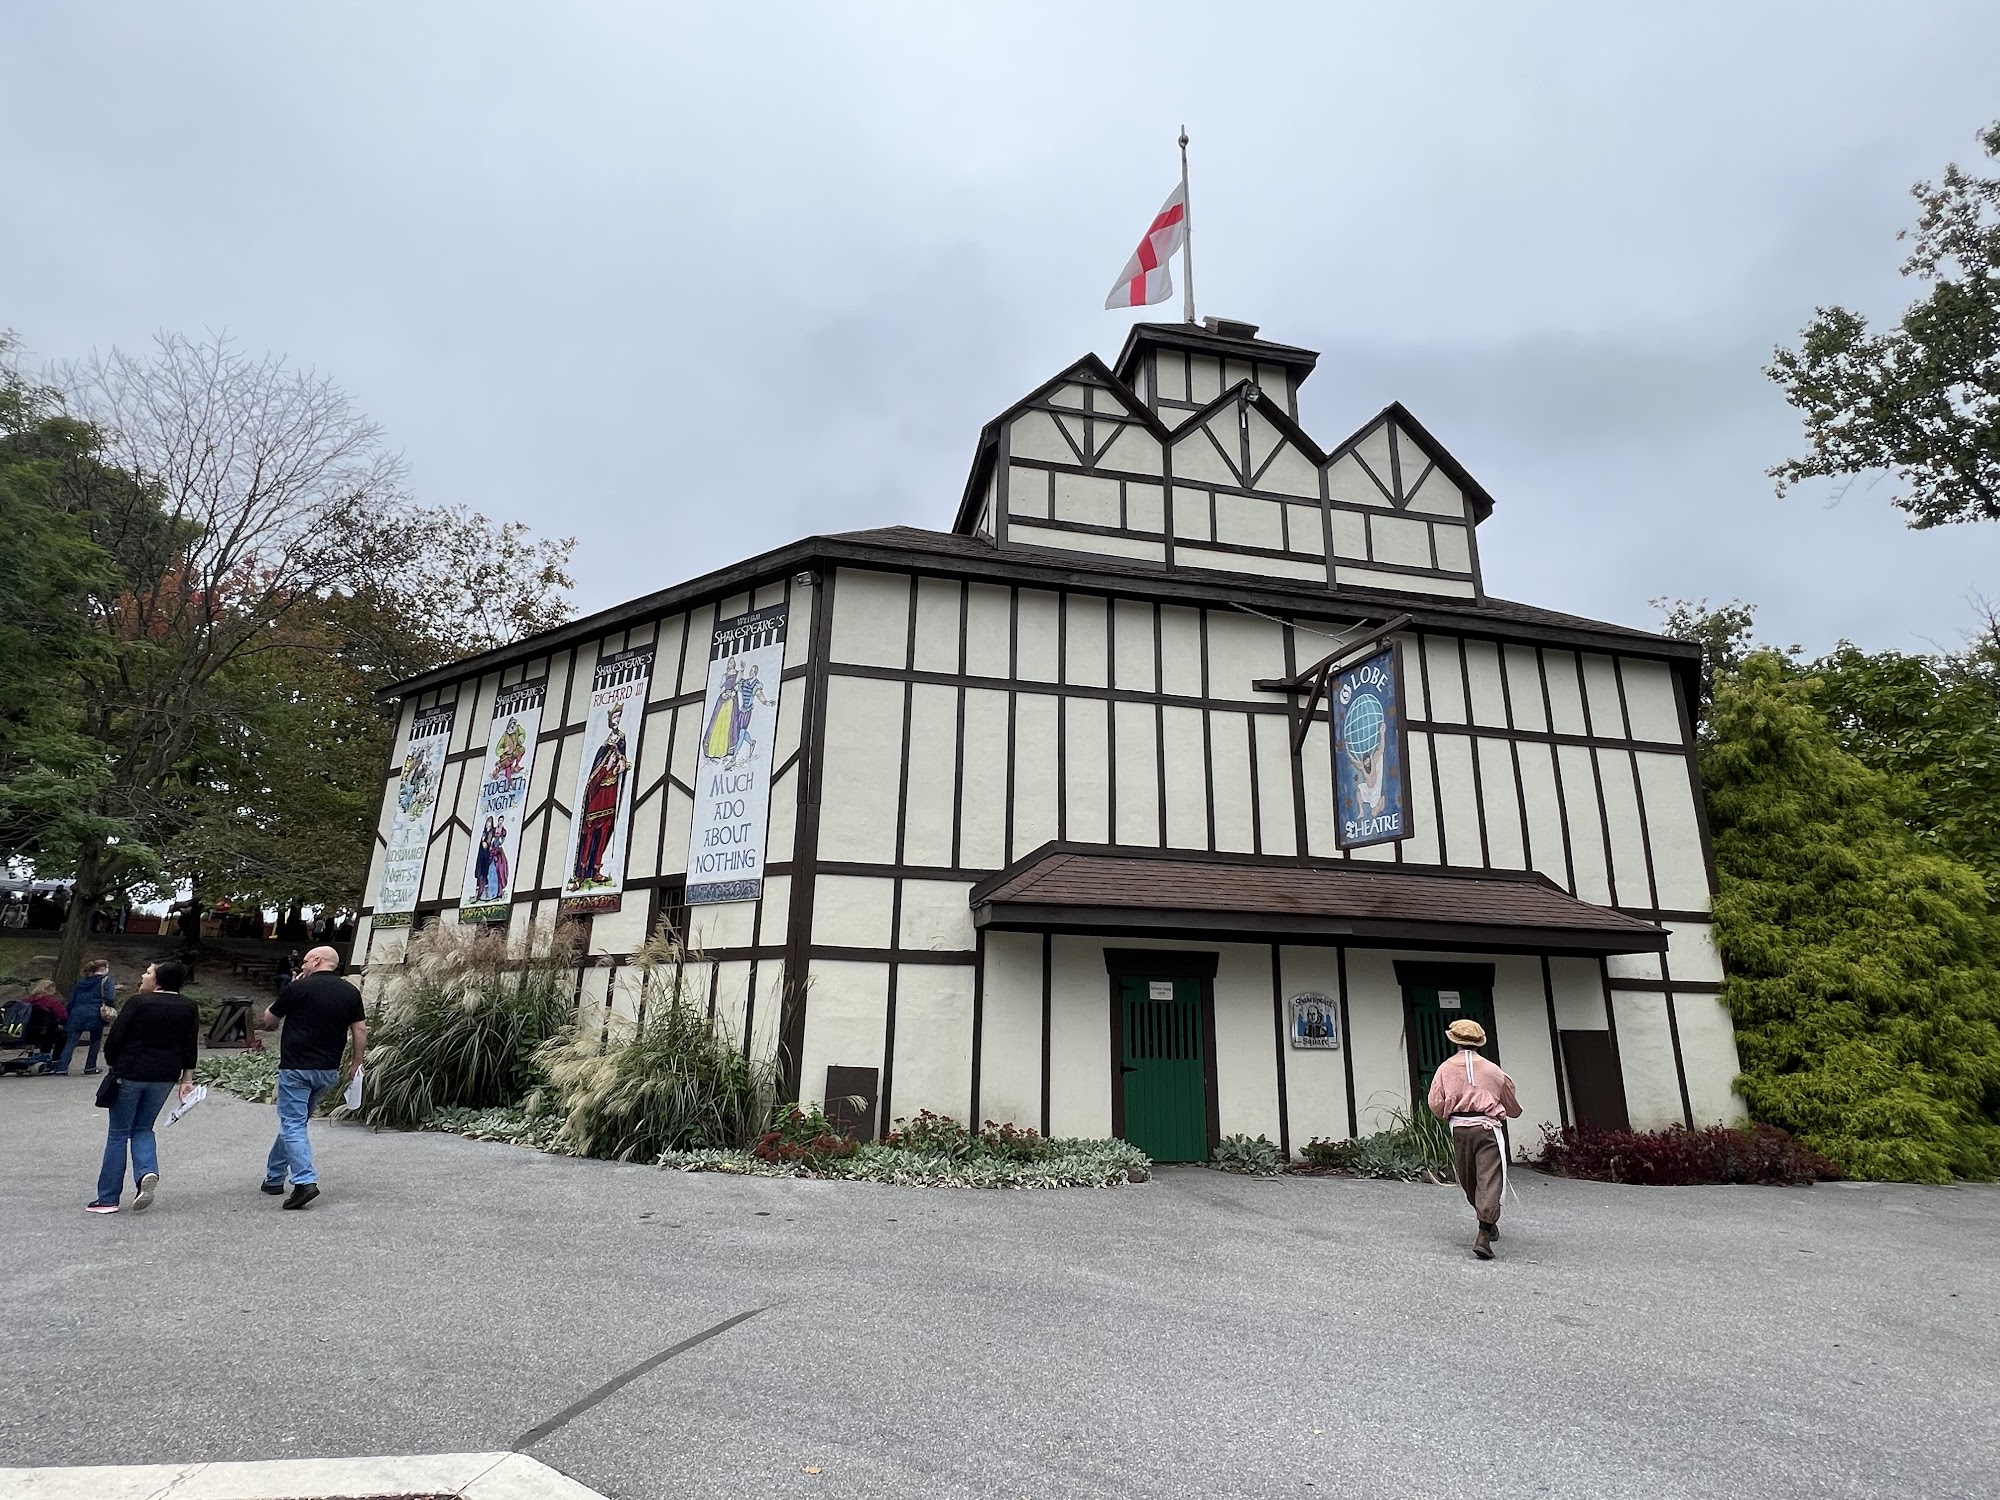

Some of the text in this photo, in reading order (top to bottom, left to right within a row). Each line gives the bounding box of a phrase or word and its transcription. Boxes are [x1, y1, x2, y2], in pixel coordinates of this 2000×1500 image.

[713, 614, 786, 646] SHAKESPEARE'S
[595, 652, 654, 678] SHAKESPEARE'S
[593, 685, 633, 708] RICHARD
[1339, 665, 1389, 705] GLOBE
[710, 772, 755, 798] MUCH
[713, 799, 745, 821] ADO
[403, 828, 412, 844] A
[703, 823, 752, 848] ABOUT
[1345, 813, 1399, 840] THEATRE
[695, 848, 756, 874] NOTHING
